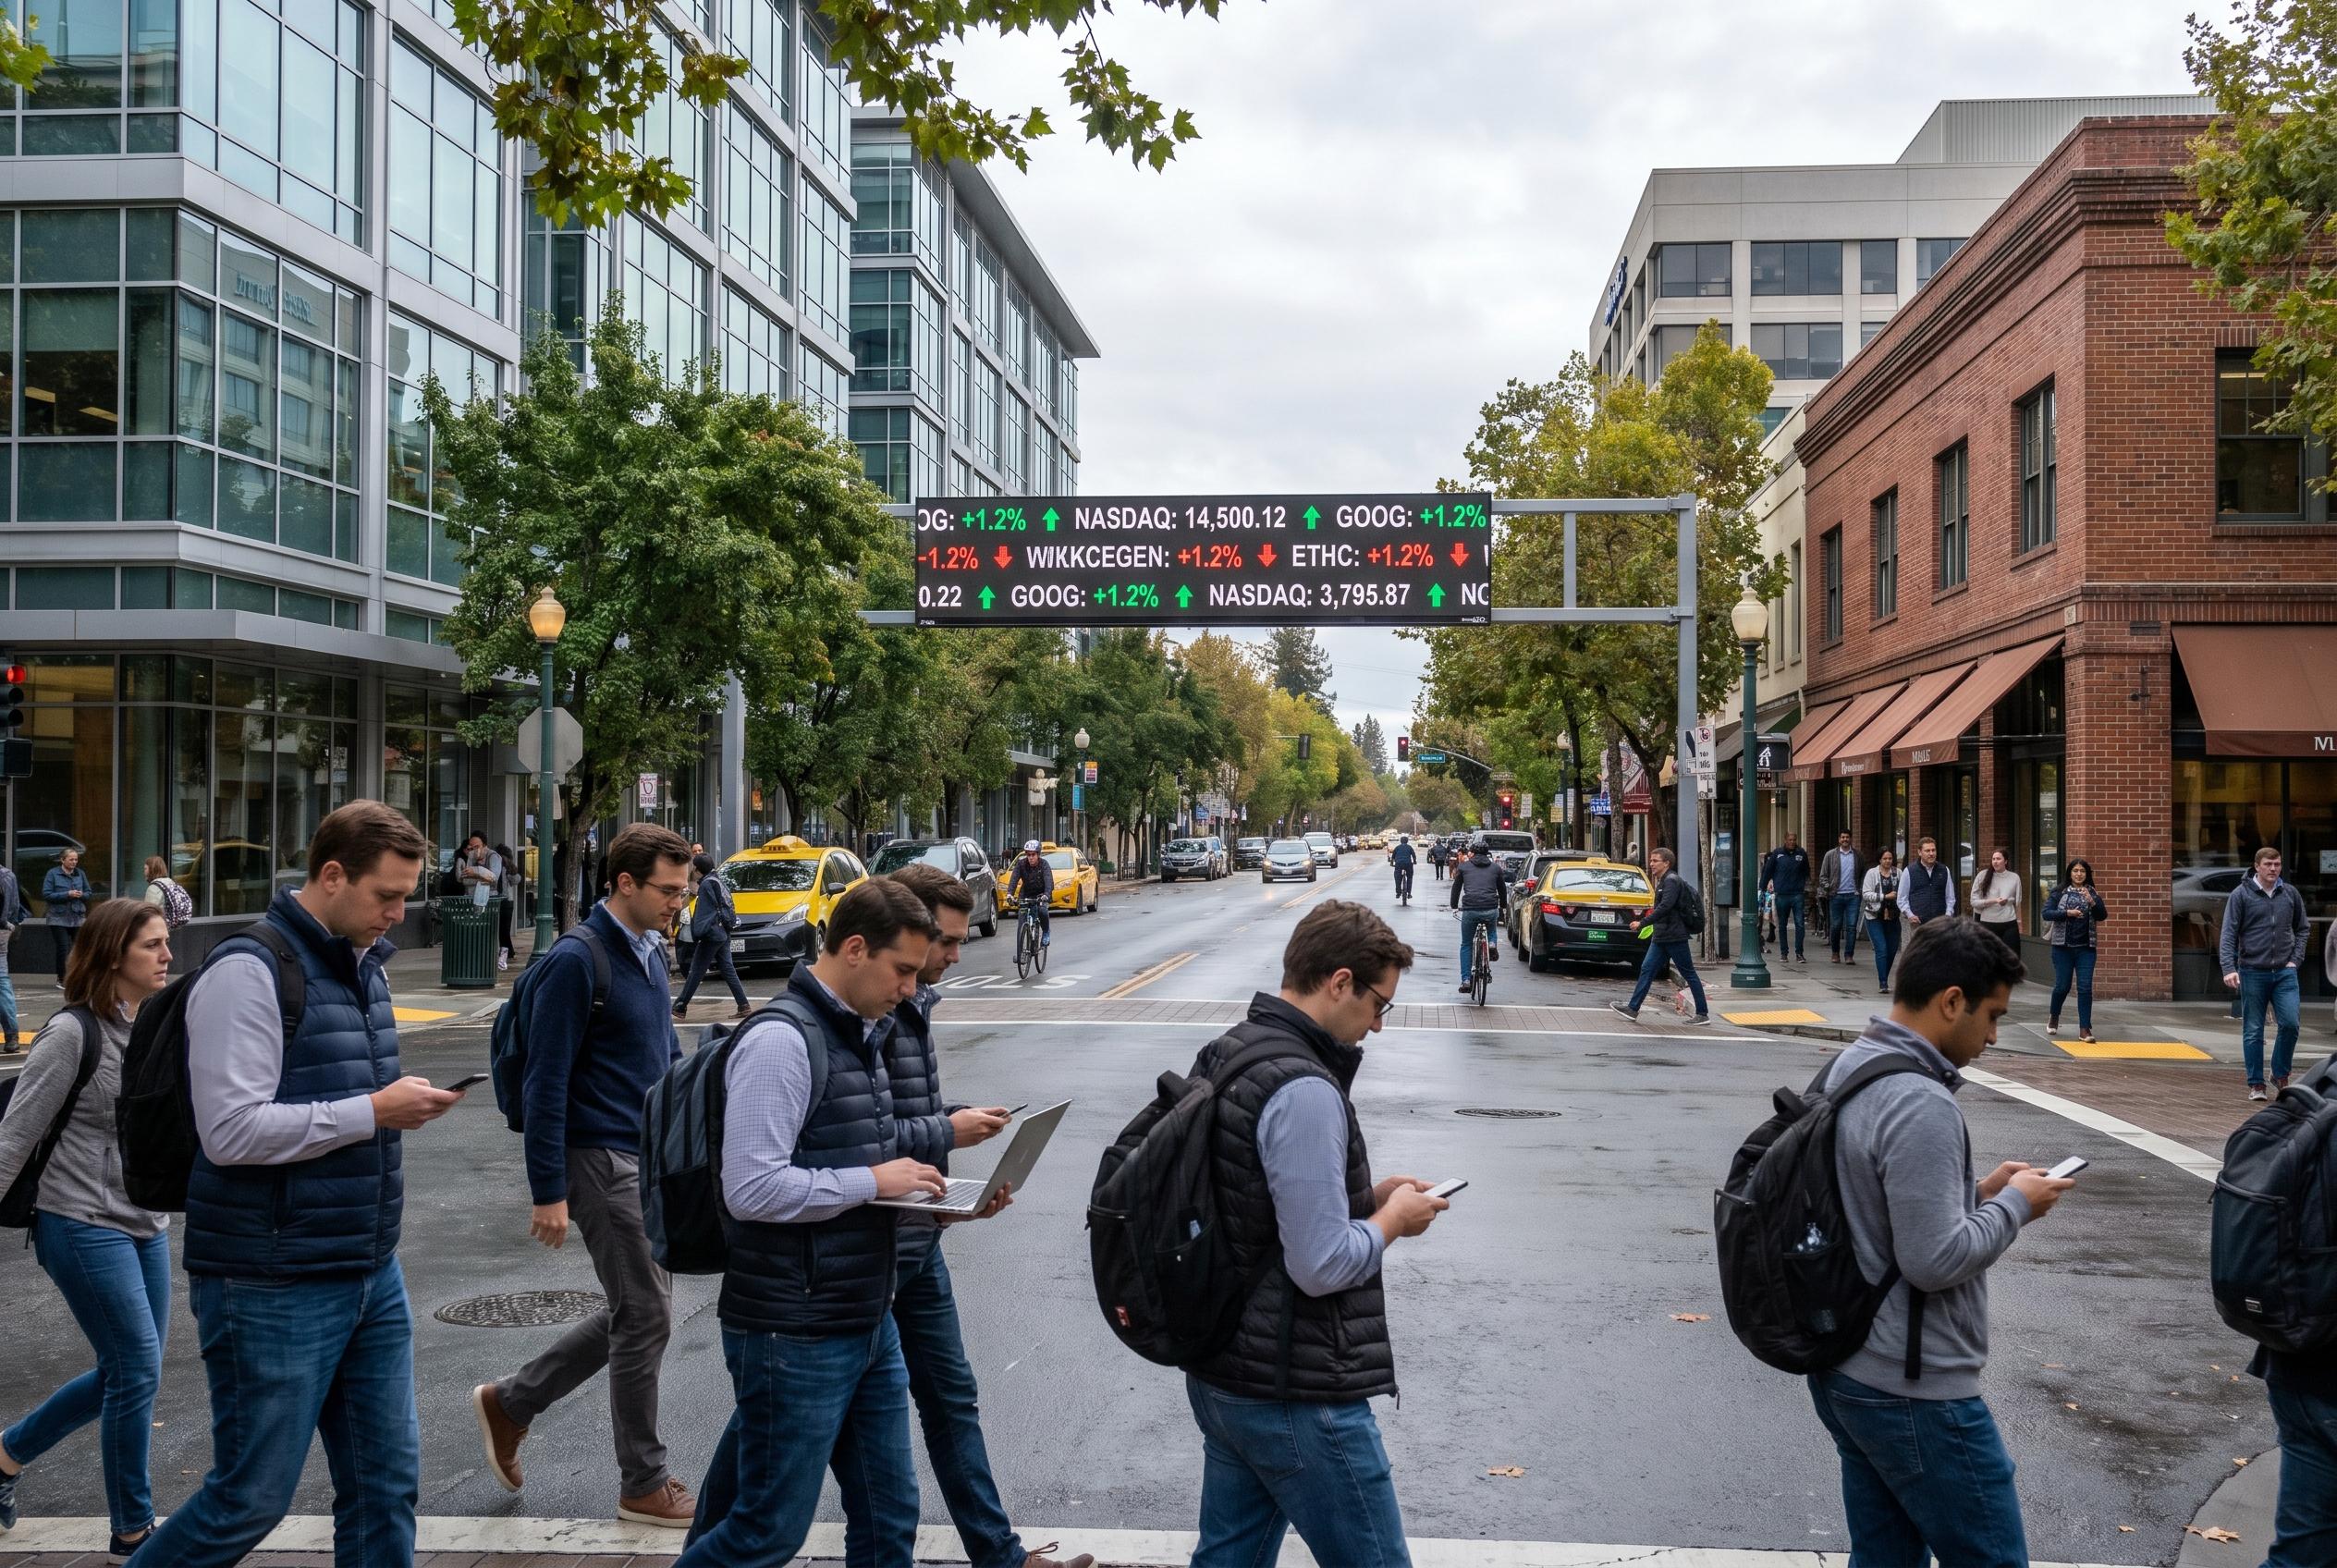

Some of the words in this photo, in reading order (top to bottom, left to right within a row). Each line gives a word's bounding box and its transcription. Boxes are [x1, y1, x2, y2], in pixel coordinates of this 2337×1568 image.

[962, 508, 1027, 532] +1.2%
[1075, 507, 1177, 531] NASDAQ:
[1185, 506, 1286, 533] 14,500.12
[1337, 505, 1413, 528] GOOG:
[1420, 505, 1487, 528] +1.2%
[1178, 545, 1242, 568] +1.2%
[1292, 545, 1360, 567] ETHC:
[1368, 544, 1434, 567] +1.2%
[918, 585, 962, 607] 0.22
[1011, 584, 1086, 607] GOOG:
[1094, 584, 1159, 607] +1.2%
[1209, 583, 1312, 607] NASDAQ:
[1320, 583, 1411, 610] 3,795.87
